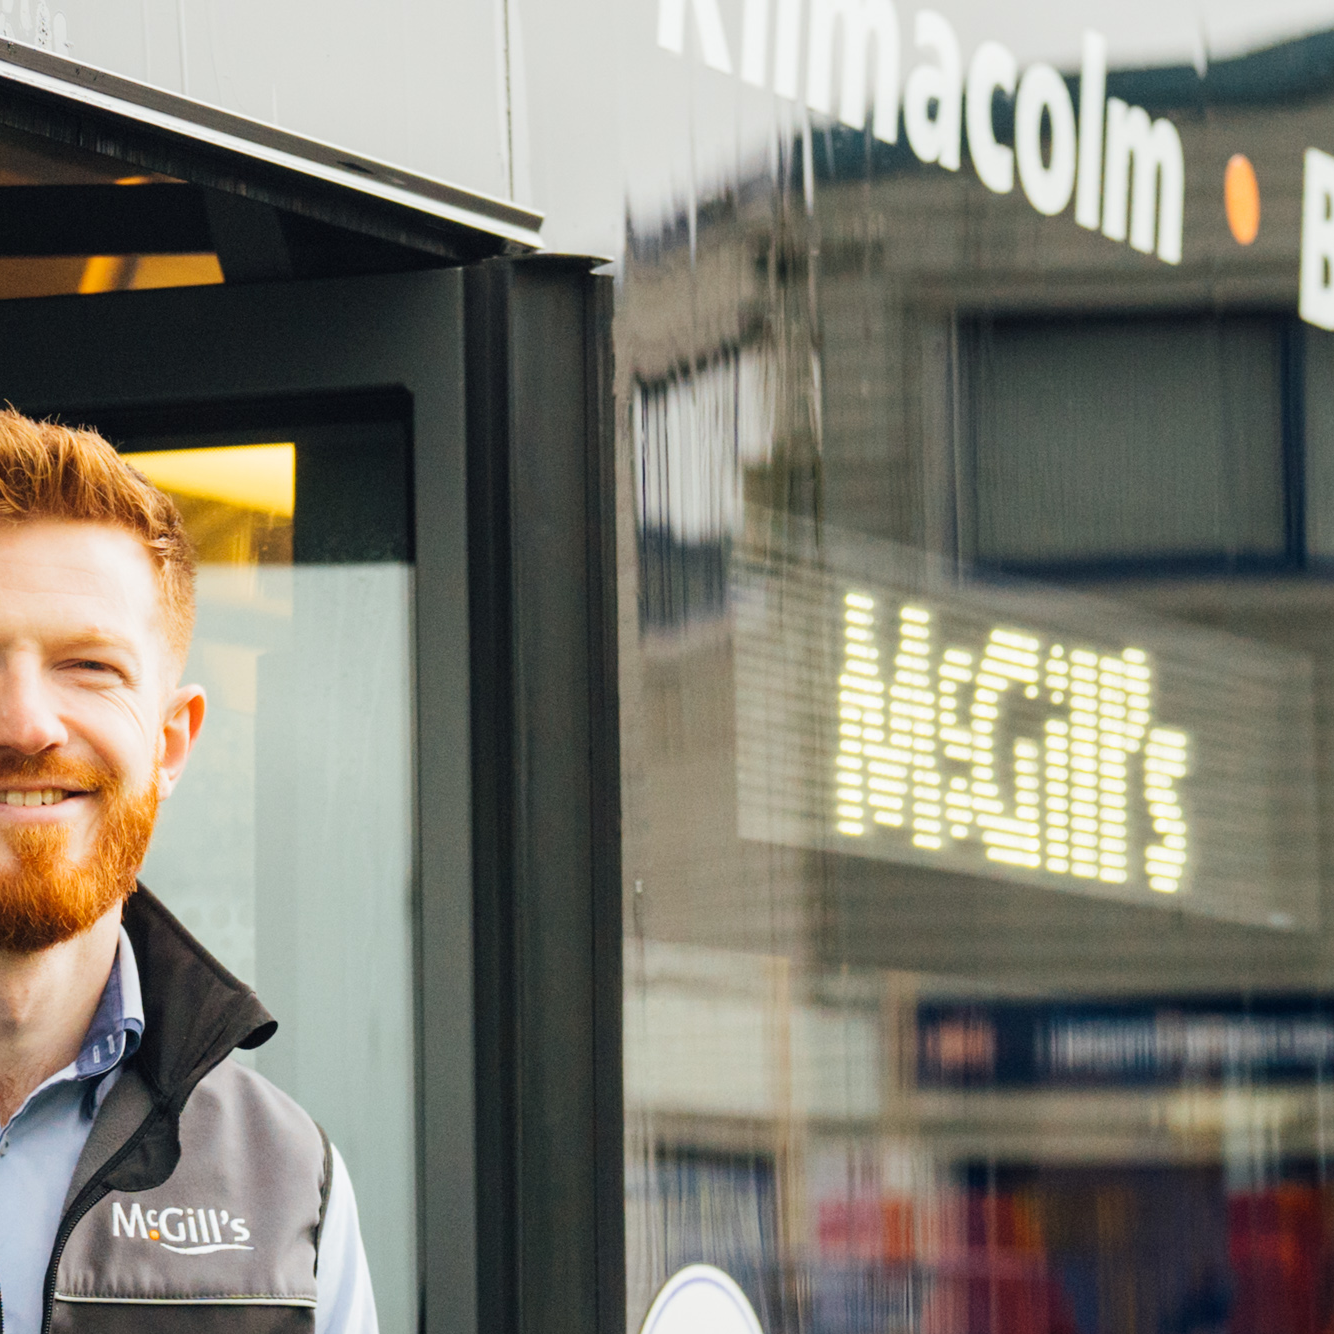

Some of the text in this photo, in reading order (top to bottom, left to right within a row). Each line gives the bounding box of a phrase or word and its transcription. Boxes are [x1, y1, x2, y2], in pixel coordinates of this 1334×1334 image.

[656, 0, 1185, 266] macolm
[835, 592, 1189, 894] McGill's
[112, 1201, 251, 1244] McGill's
